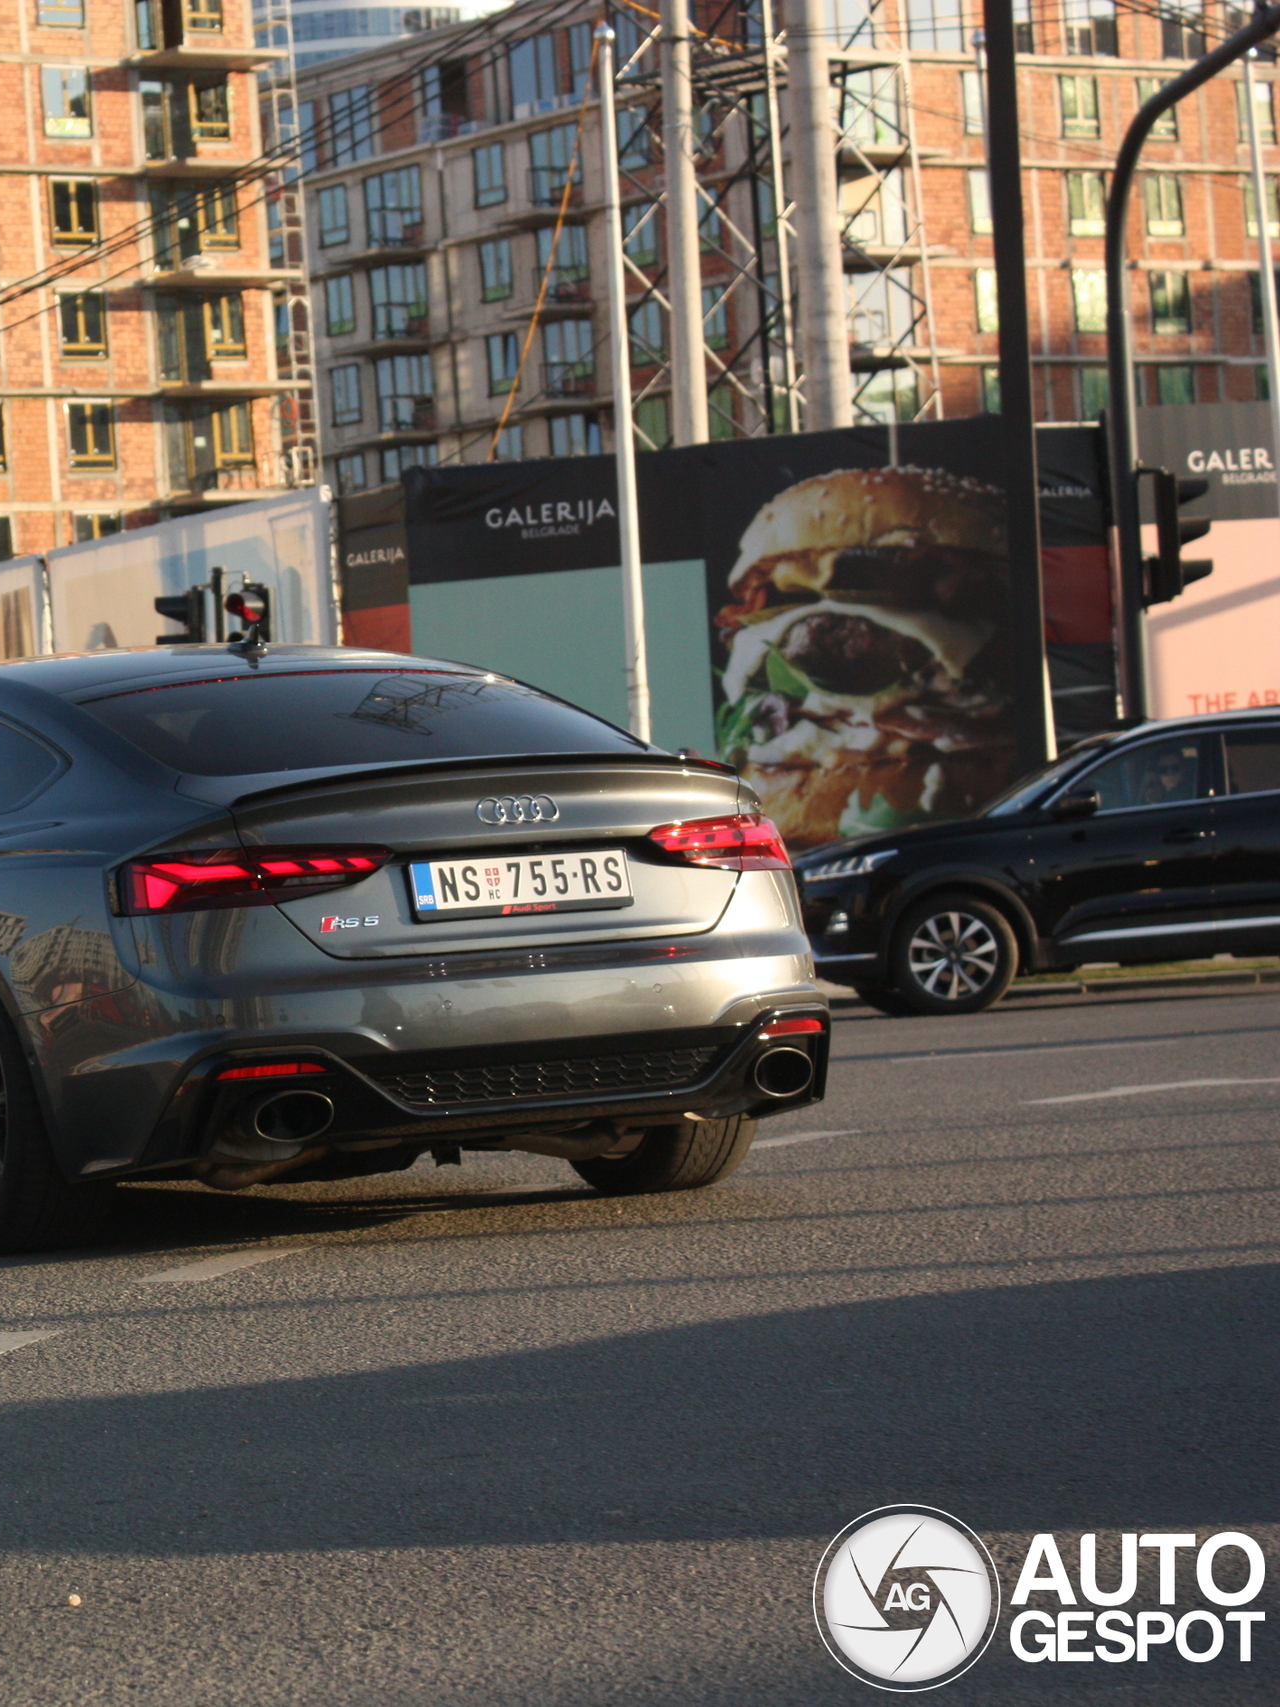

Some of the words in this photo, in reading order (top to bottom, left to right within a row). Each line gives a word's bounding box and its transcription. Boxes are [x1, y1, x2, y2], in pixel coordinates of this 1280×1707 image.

[1039, 486, 1092, 499] ALERIJA
[485, 498, 615, 528] GALERIJA
[521, 524, 579, 539] BELGRADE
[346, 547, 405, 567] GALERIJA
[438, 865, 481, 903] NS
[419, 894, 434, 905] SRB
[513, 904, 532, 912] Audi
[533, 903, 557, 912] Sport
[363, 915, 379, 926] 5
